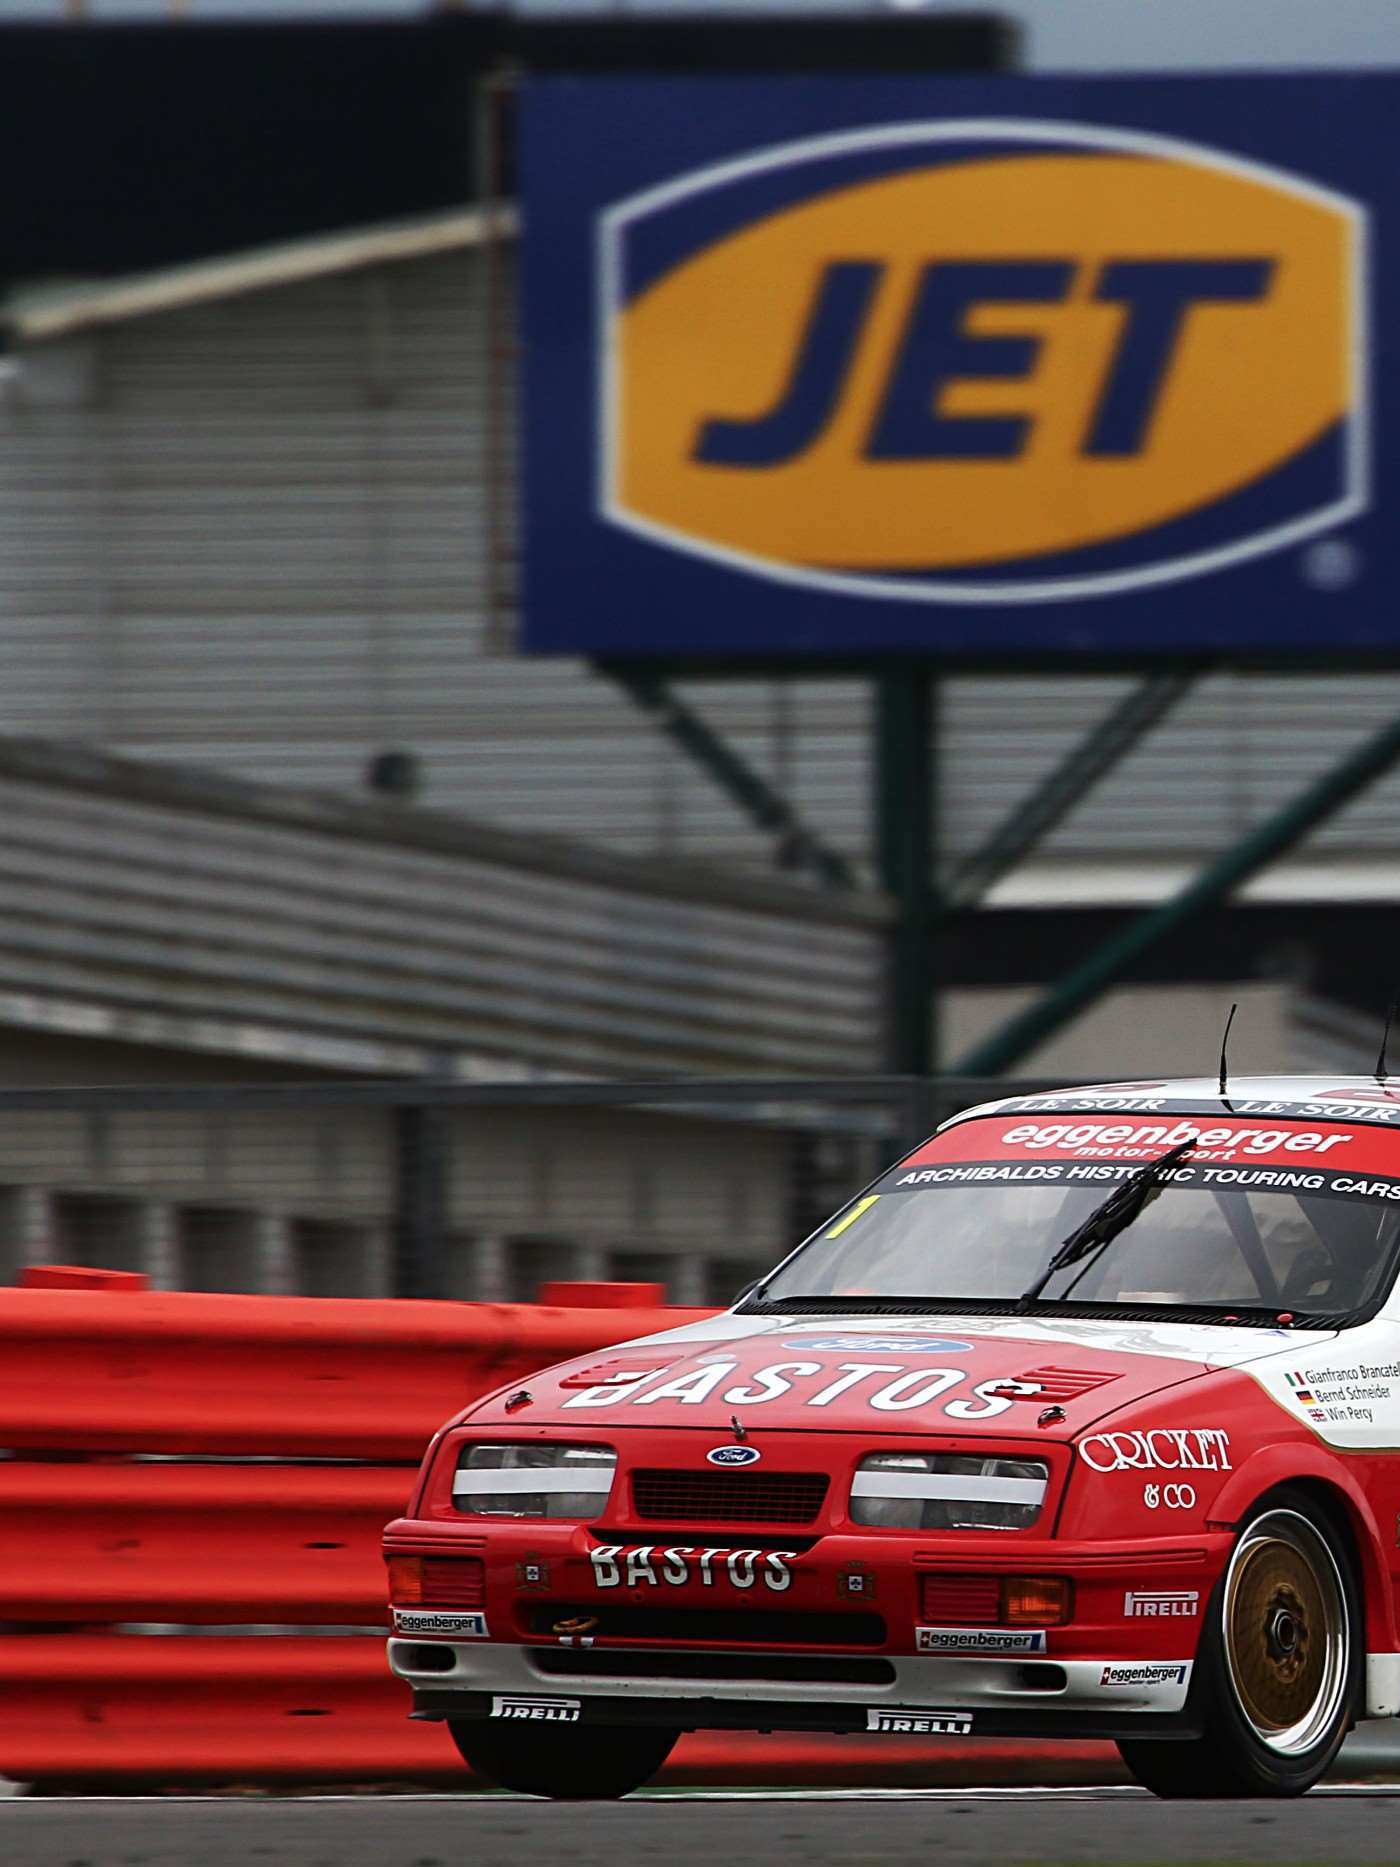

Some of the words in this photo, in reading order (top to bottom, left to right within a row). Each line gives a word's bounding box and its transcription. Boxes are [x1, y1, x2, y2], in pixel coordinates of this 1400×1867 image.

[686, 255, 1281, 470] JET
[1014, 1099, 1059, 1112] LE
[1070, 1099, 1168, 1112] SOIR
[1233, 1101, 1285, 1114] LE
[1297, 1103, 1400, 1122] SOIR
[1002, 1121, 1353, 1155] eggenberger
[1073, 1146, 1237, 1162] motor-port
[896, 1165, 1063, 1186] ARCHIBALDS
[1202, 1169, 1323, 1190] TOURING
[825, 1194, 881, 1239] 1
[1305, 1367, 1358, 1384] Gianfranco
[560, 1361, 1042, 1420] BASTOS
[1315, 1387, 1346, 1402] Bernd
[1346, 1384, 1391, 1400] Schneider
[1326, 1407, 1347, 1421] Win
[1347, 1406, 1373, 1422] Percy
[1078, 1429, 1232, 1472] CRICKET
[1163, 1483, 1196, 1509] CO
[590, 1545, 797, 1591] BASTOS
[1124, 1591, 1199, 1616] PIRELLI
[402, 1615, 474, 1630] eggenberger
[930, 1633, 1030, 1648] eggenberger
[1111, 1665, 1180, 1681] eggenberger
[489, 1696, 581, 1721] PIRELLI
[866, 1709, 973, 1734] PIRELLI
